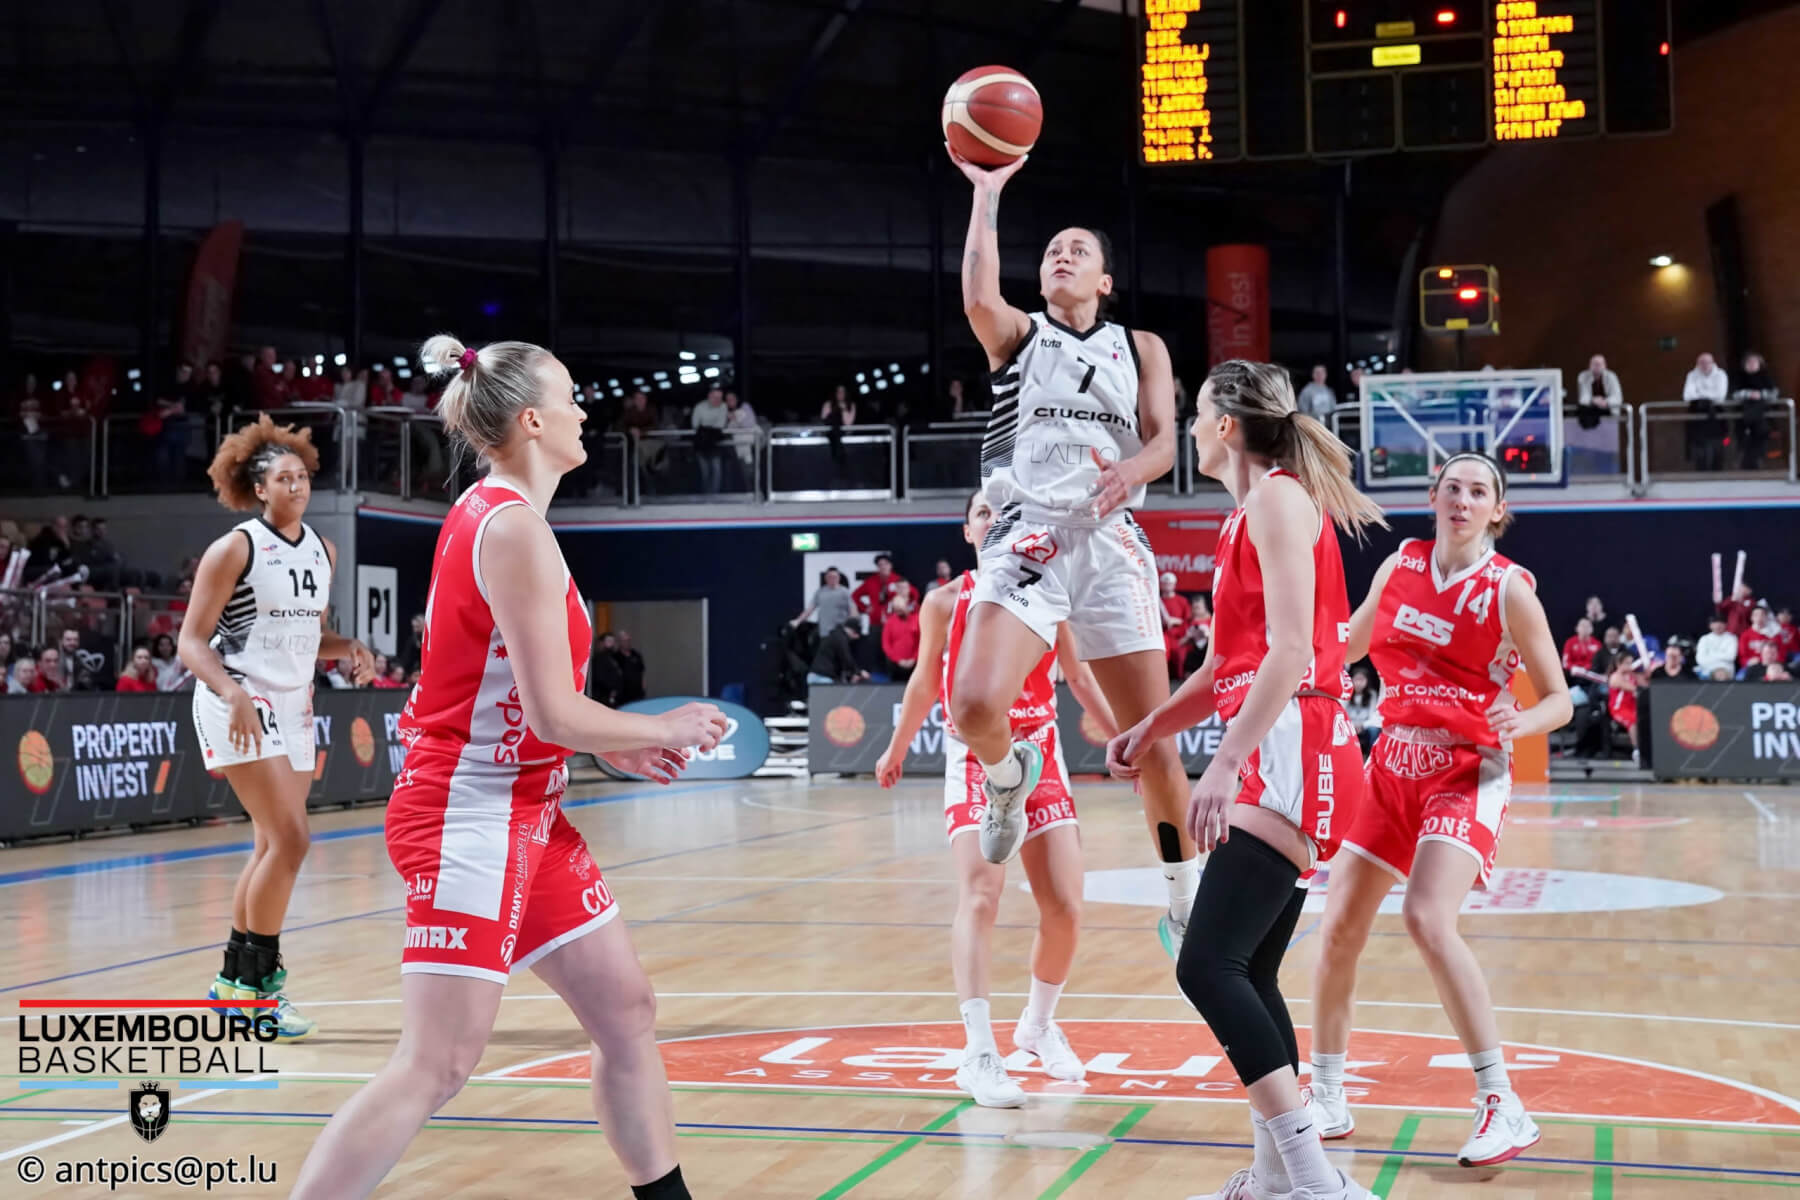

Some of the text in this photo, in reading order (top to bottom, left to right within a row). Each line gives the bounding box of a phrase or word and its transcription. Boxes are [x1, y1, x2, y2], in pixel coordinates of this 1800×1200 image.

[1077, 356, 1096, 394] 7
[1034, 407, 1131, 430] cruciani
[1031, 442, 1117, 464] L'ALTO
[289, 568, 317, 598] 14
[1453, 579, 1494, 624] 14
[368, 587, 392, 635] P1
[1393, 603, 1455, 646] PSS
[72, 721, 177, 760] PROPERTY
[75, 761, 149, 801] INVEST
